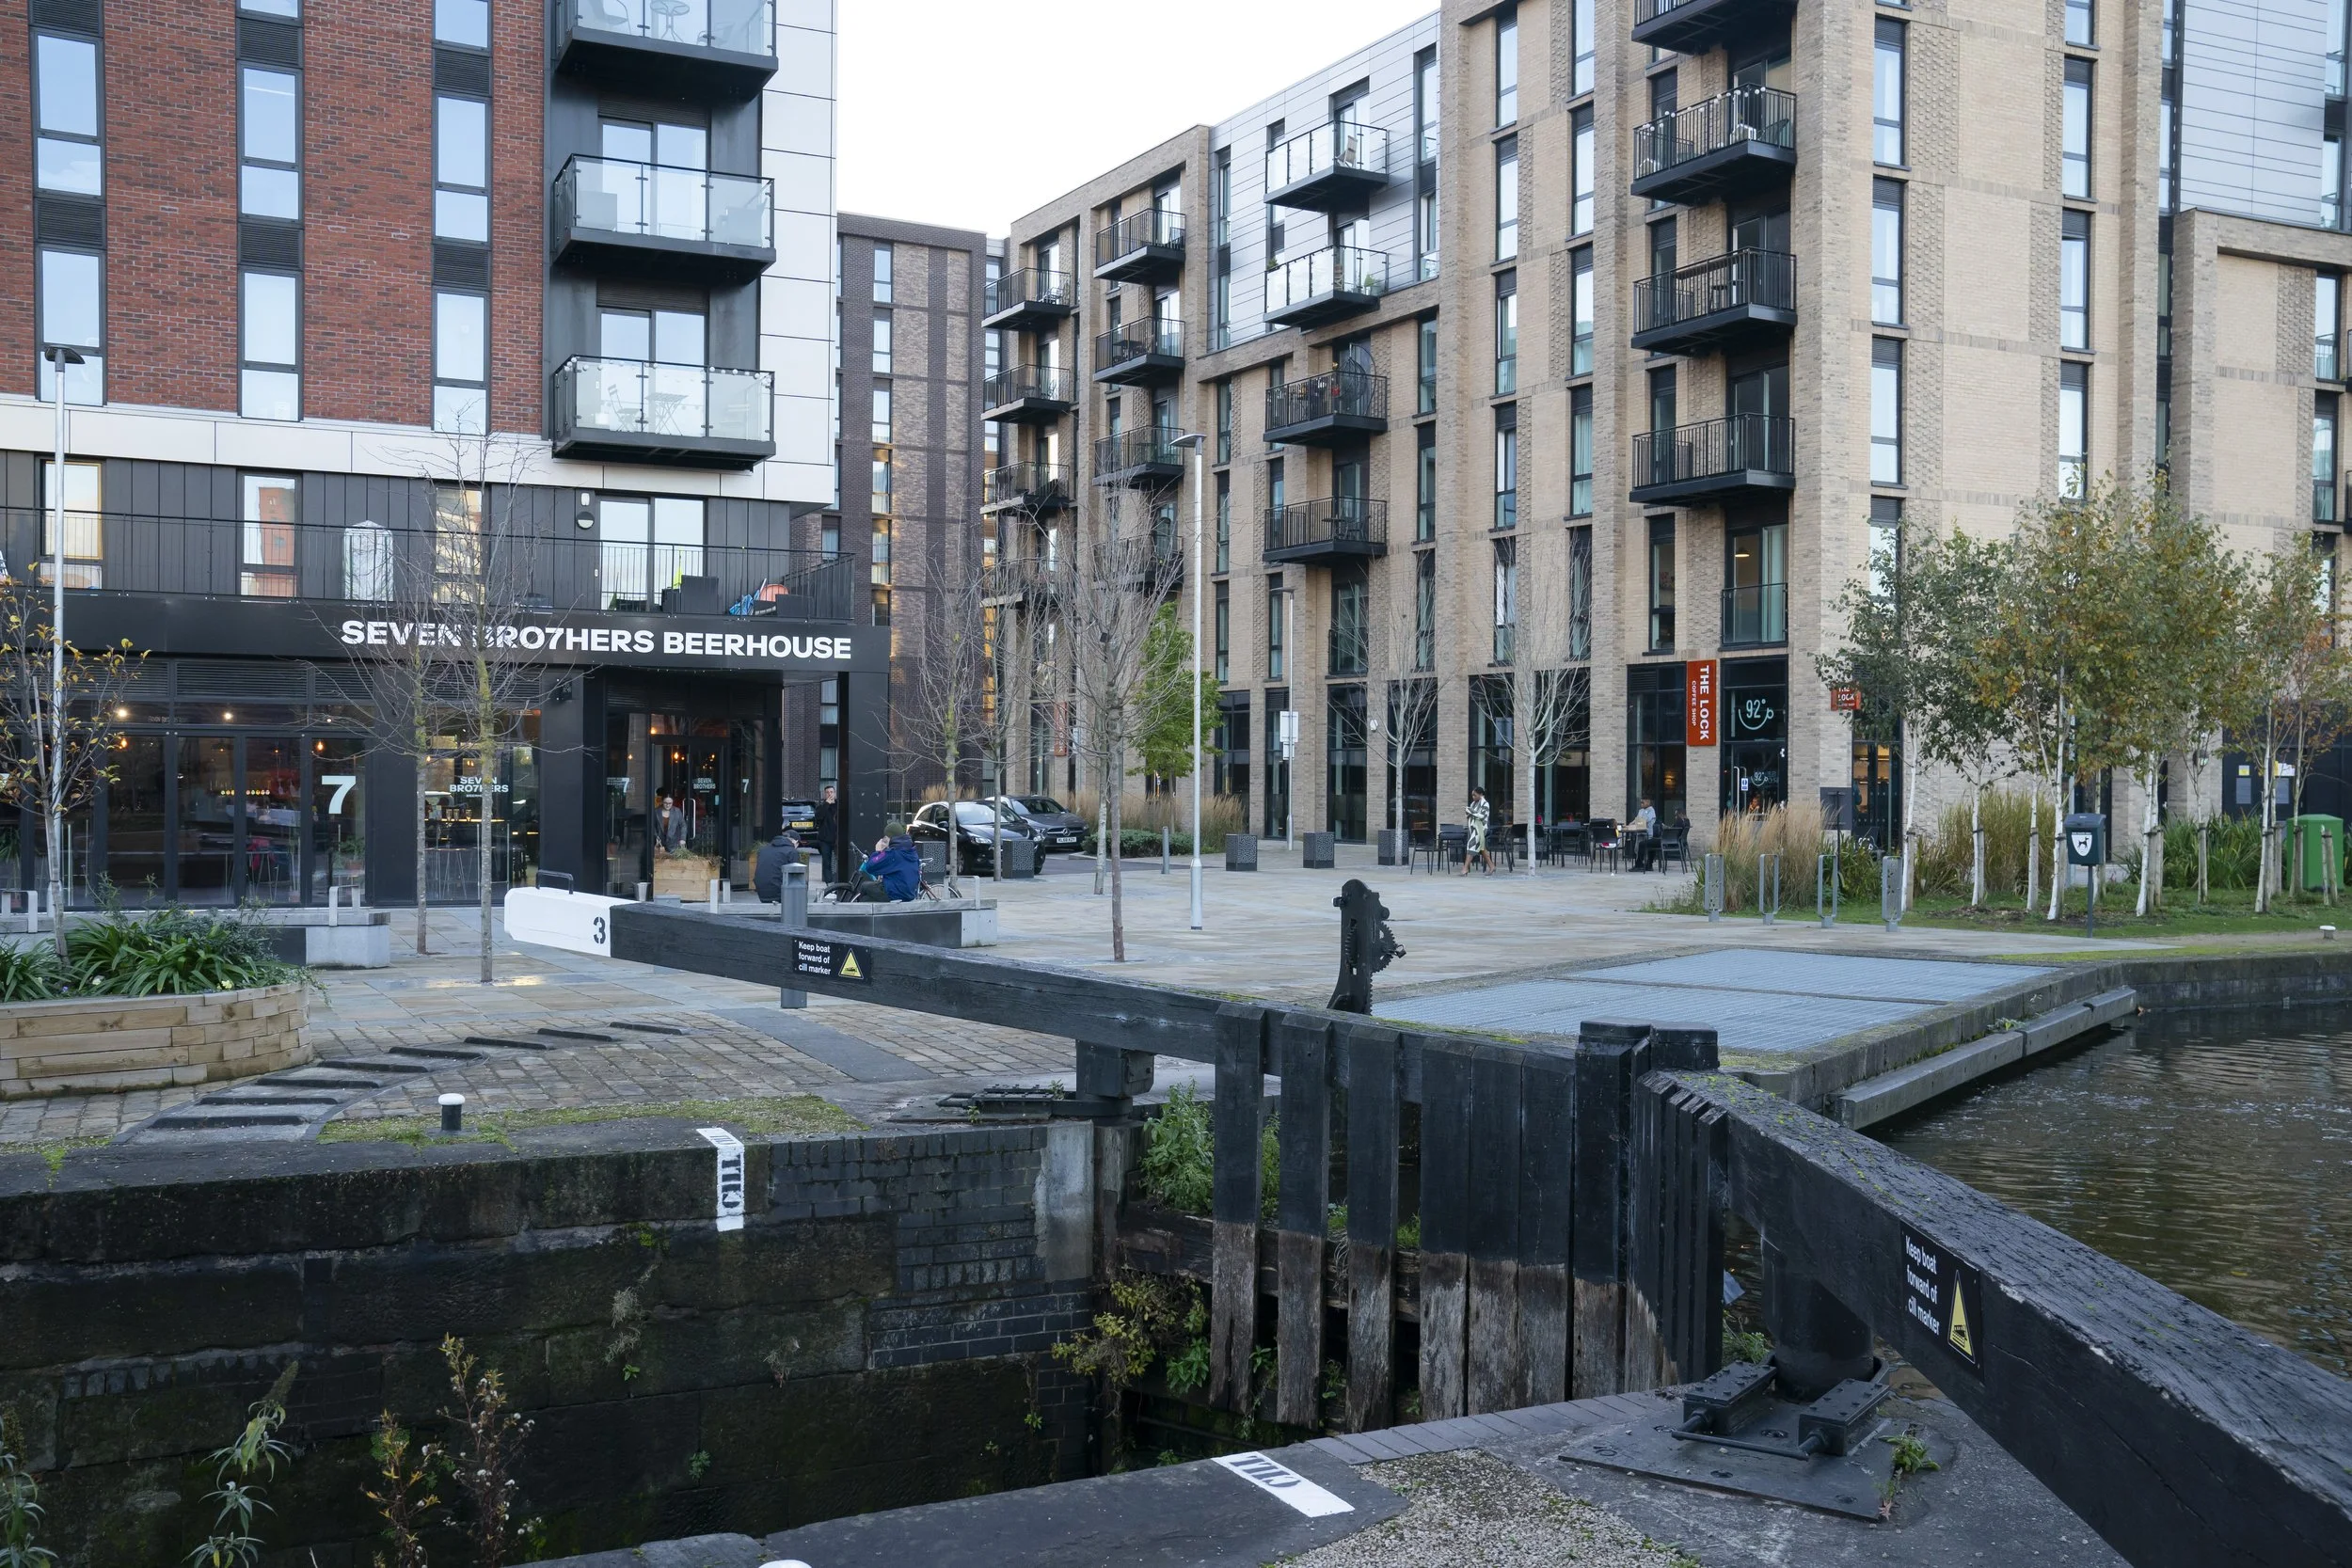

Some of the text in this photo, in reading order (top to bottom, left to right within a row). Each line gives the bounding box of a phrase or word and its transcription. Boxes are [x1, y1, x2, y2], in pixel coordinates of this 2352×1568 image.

[342, 620, 851, 659] SEVEN BRO7HERS BEERHOUSE
[1700, 665, 1709, 740] THE LOCK
[322, 775, 357, 815] 7
[621, 777, 630, 793] 7
[742, 778, 750, 794] 7
[593, 916, 607, 944] 3
[798, 941, 831, 954] Keep boat
[798, 951, 831, 964] forward of
[798, 962, 831, 975] cill marker
[1905, 1235, 1937, 1275] Keep boat
[1906, 1264, 1938, 1305] forward of
[1908, 1295, 1940, 1336] cill marker
[1229, 1455, 1302, 1488] CILL
